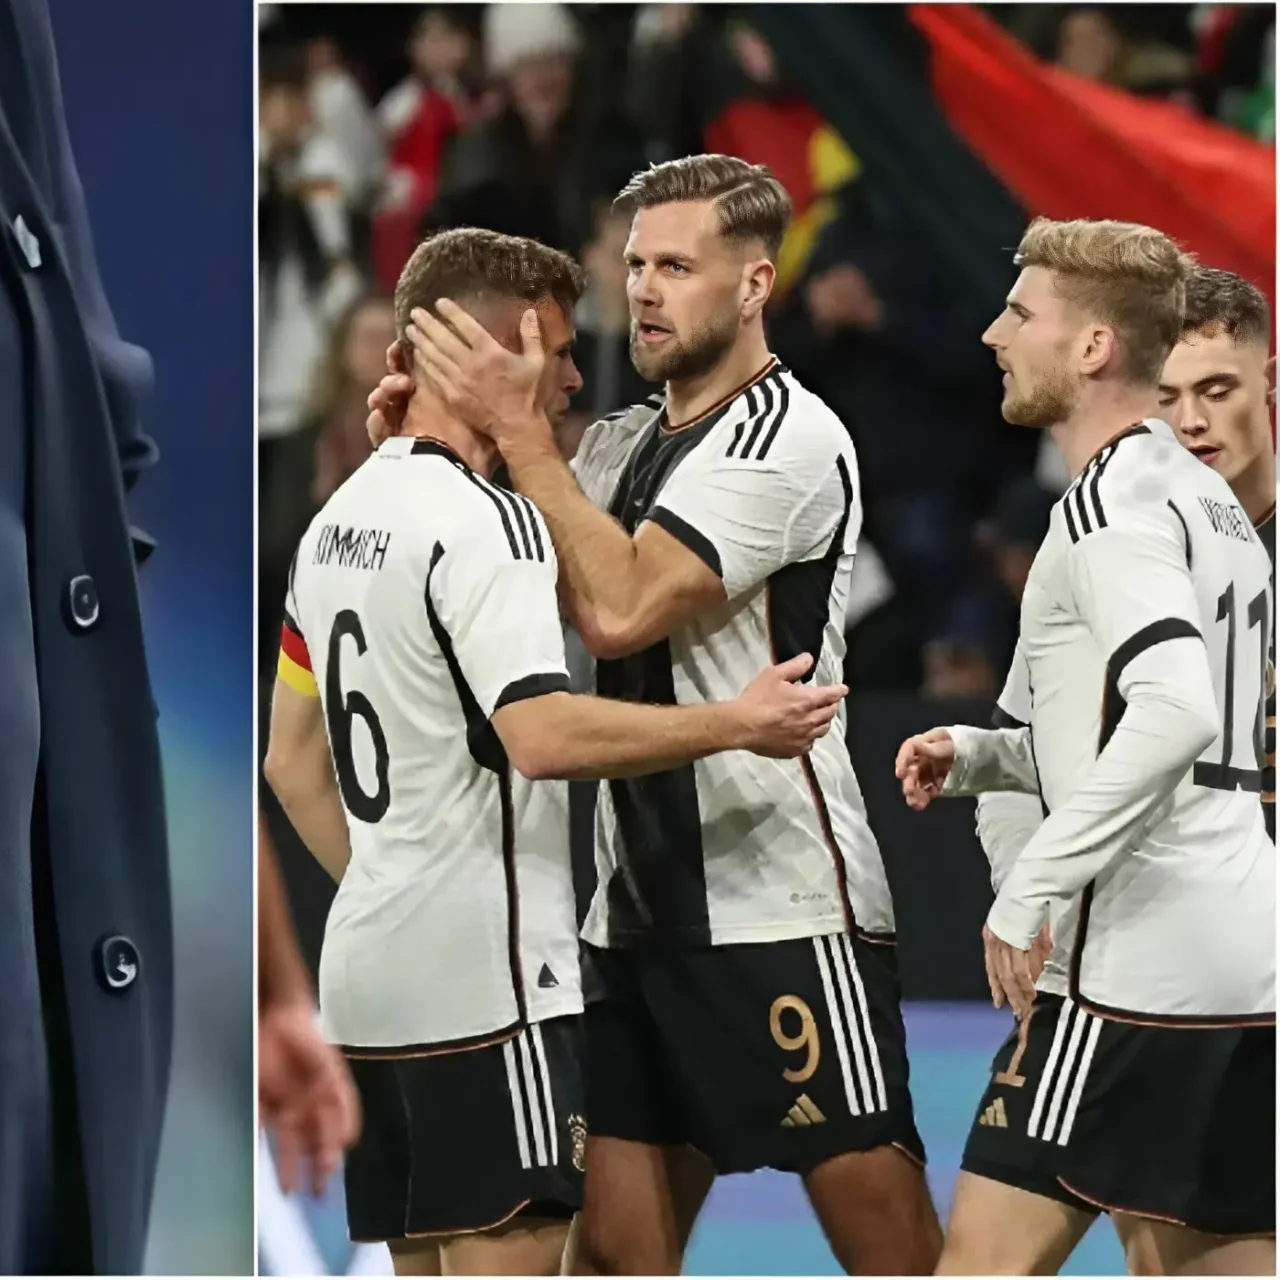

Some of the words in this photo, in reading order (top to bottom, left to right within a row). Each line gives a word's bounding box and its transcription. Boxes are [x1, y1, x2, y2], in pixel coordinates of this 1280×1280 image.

[326, 609, 391, 824] 6
[1193, 580, 1269, 794] 11
[770, 994, 821, 1083] 9
